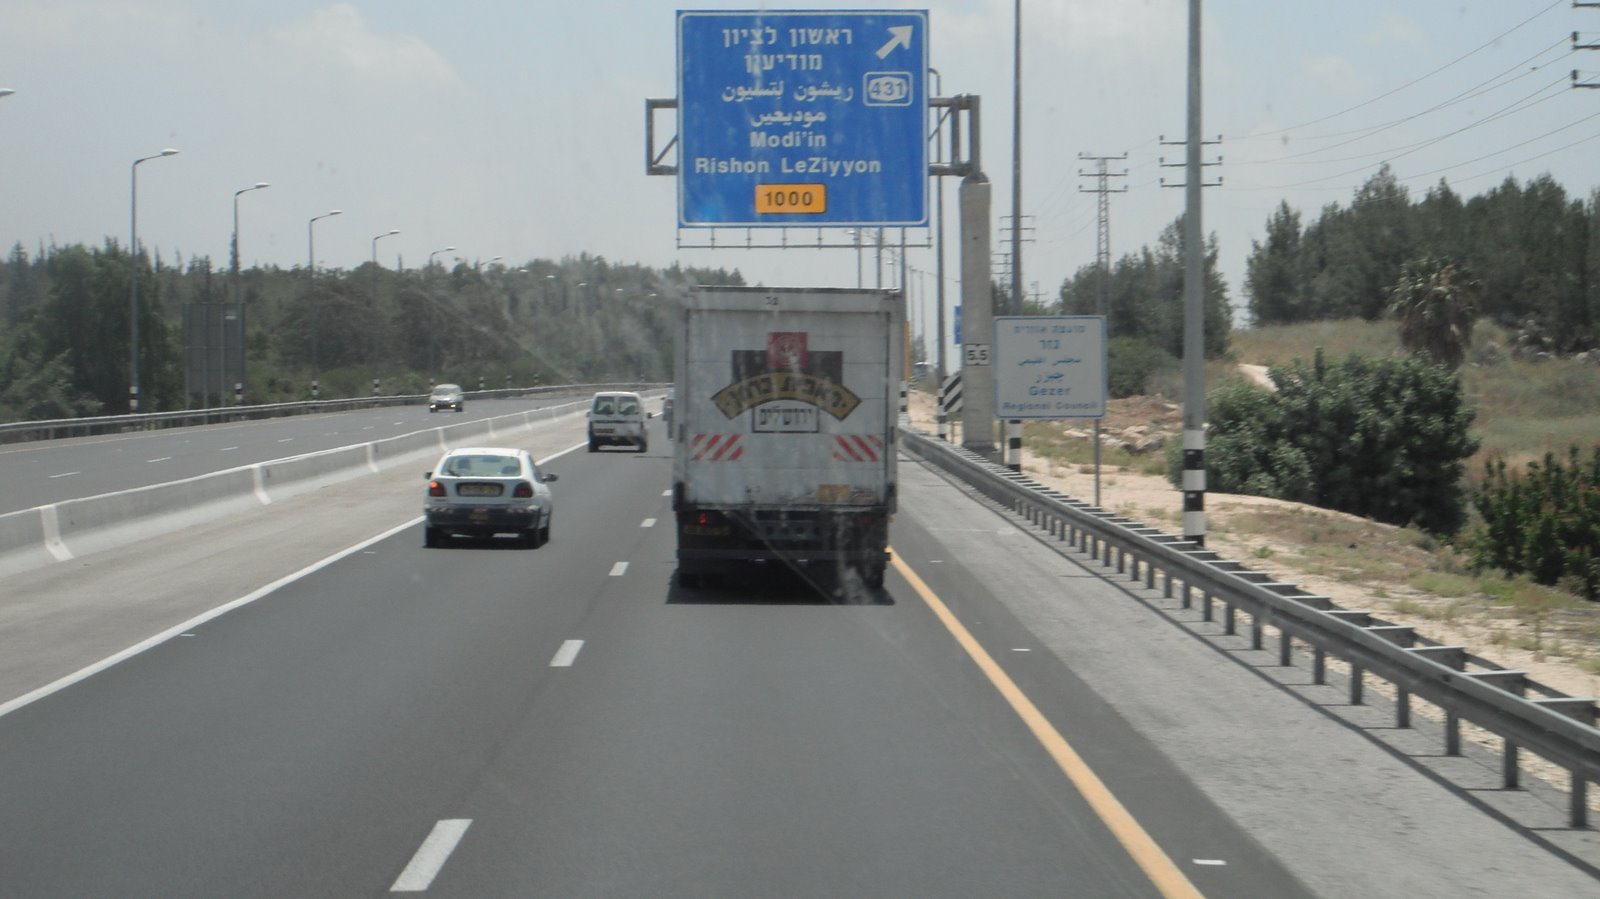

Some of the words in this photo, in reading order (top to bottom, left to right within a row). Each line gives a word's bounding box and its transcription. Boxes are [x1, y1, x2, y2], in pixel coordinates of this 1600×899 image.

[721, 26, 778, 48] לציון
[788, 27, 853, 48] ראשון
[743, 53, 823, 74] מודיעין
[871, 81, 904, 97] 431
[750, 131, 827, 148] Modi'in
[694, 157, 770, 174] Rishon
[781, 157, 882, 177] LeZiyyon
[765, 191, 813, 207] 1000
[1029, 386, 1071, 396] Gezer
